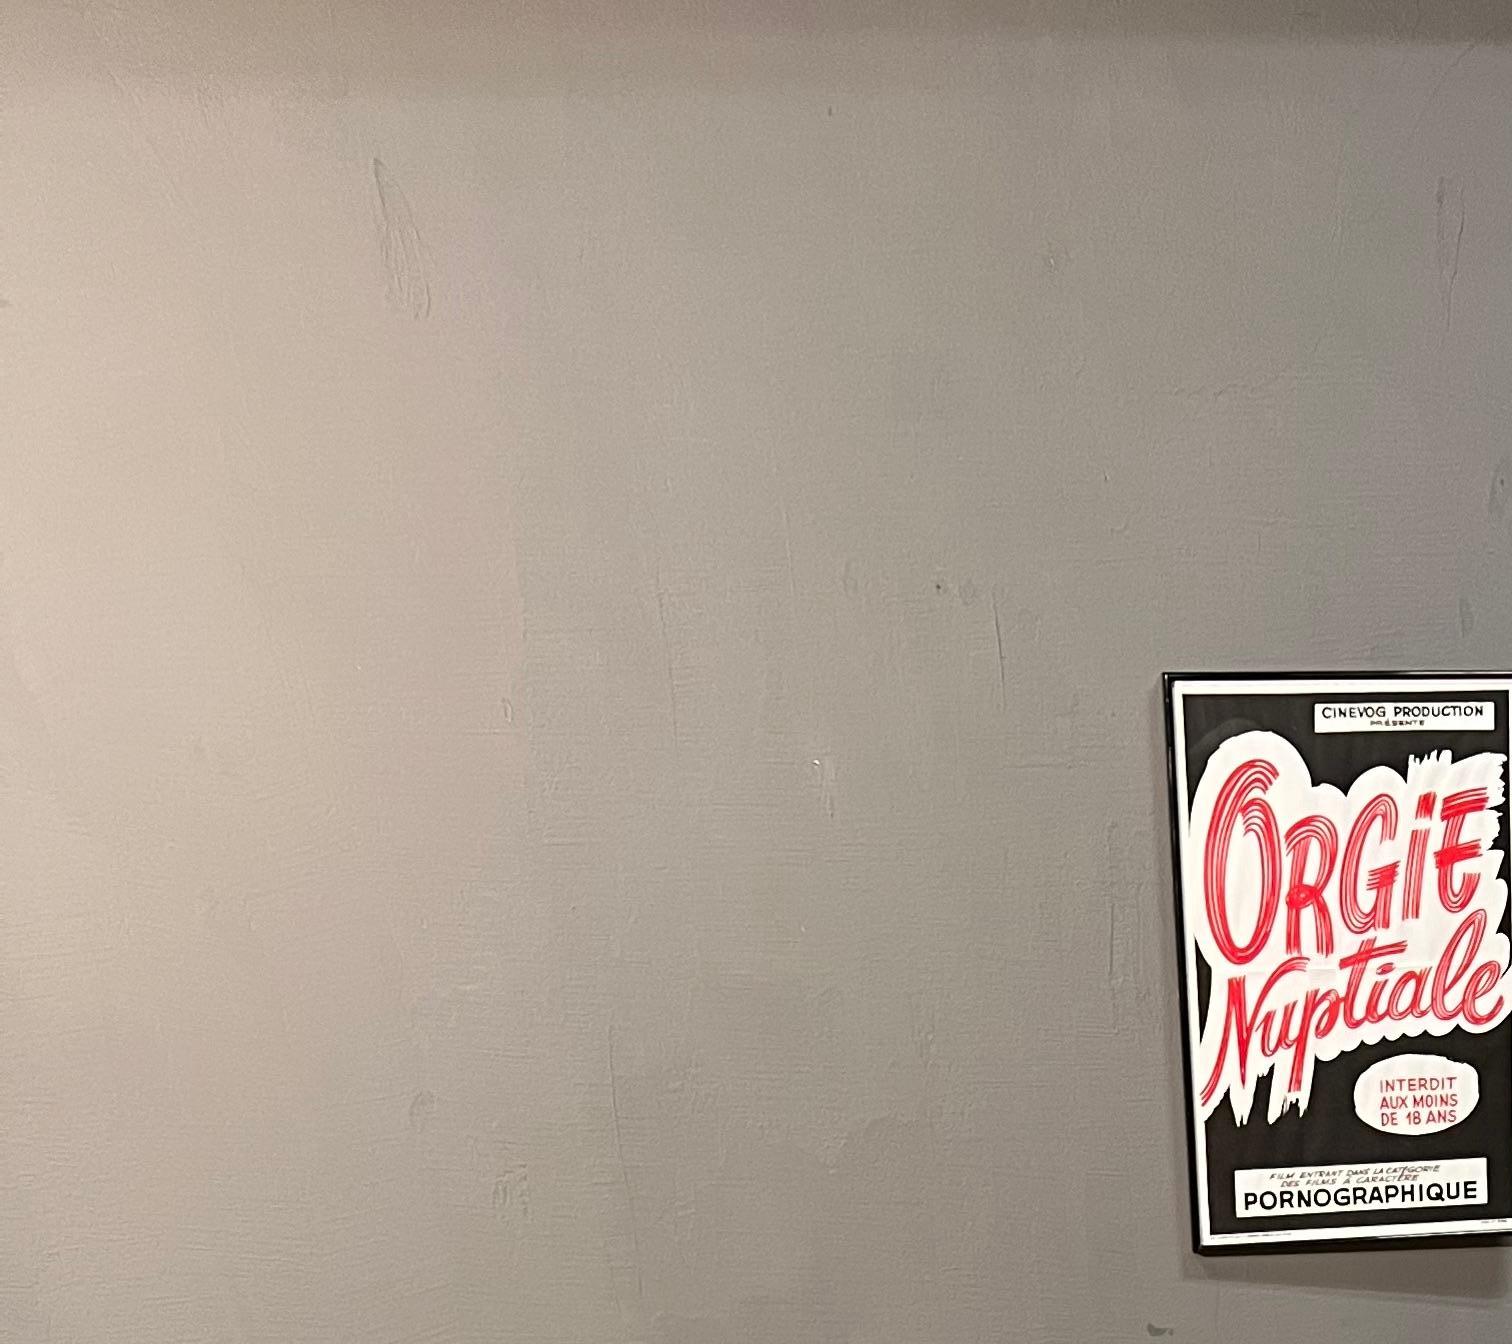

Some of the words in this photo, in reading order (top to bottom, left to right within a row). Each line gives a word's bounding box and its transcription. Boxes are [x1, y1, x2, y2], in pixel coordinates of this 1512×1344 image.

[1321, 706, 1386, 719] CINEVOG
[1393, 705, 1484, 718] PRODUCTION
[1199, 908, 1505, 1107] Nuptiale
[1379, 1076, 1458, 1094] INTERDIT
[1379, 1095, 1409, 1111] AUX
[1412, 1093, 1458, 1109] MOINS
[1381, 1111, 1399, 1127] DE
[1406, 1110, 1422, 1126] 18
[1425, 1109, 1457, 1125] ANS
[1269, 1172, 1296, 1180] FILM
[1299, 1169, 1344, 1179] ENTRANT
[1280, 1180, 1300, 1188] DES
[1305, 1178, 1337, 1186] FILMS
[1244, 1180, 1478, 1211] PORNOGRAPHIQUE
